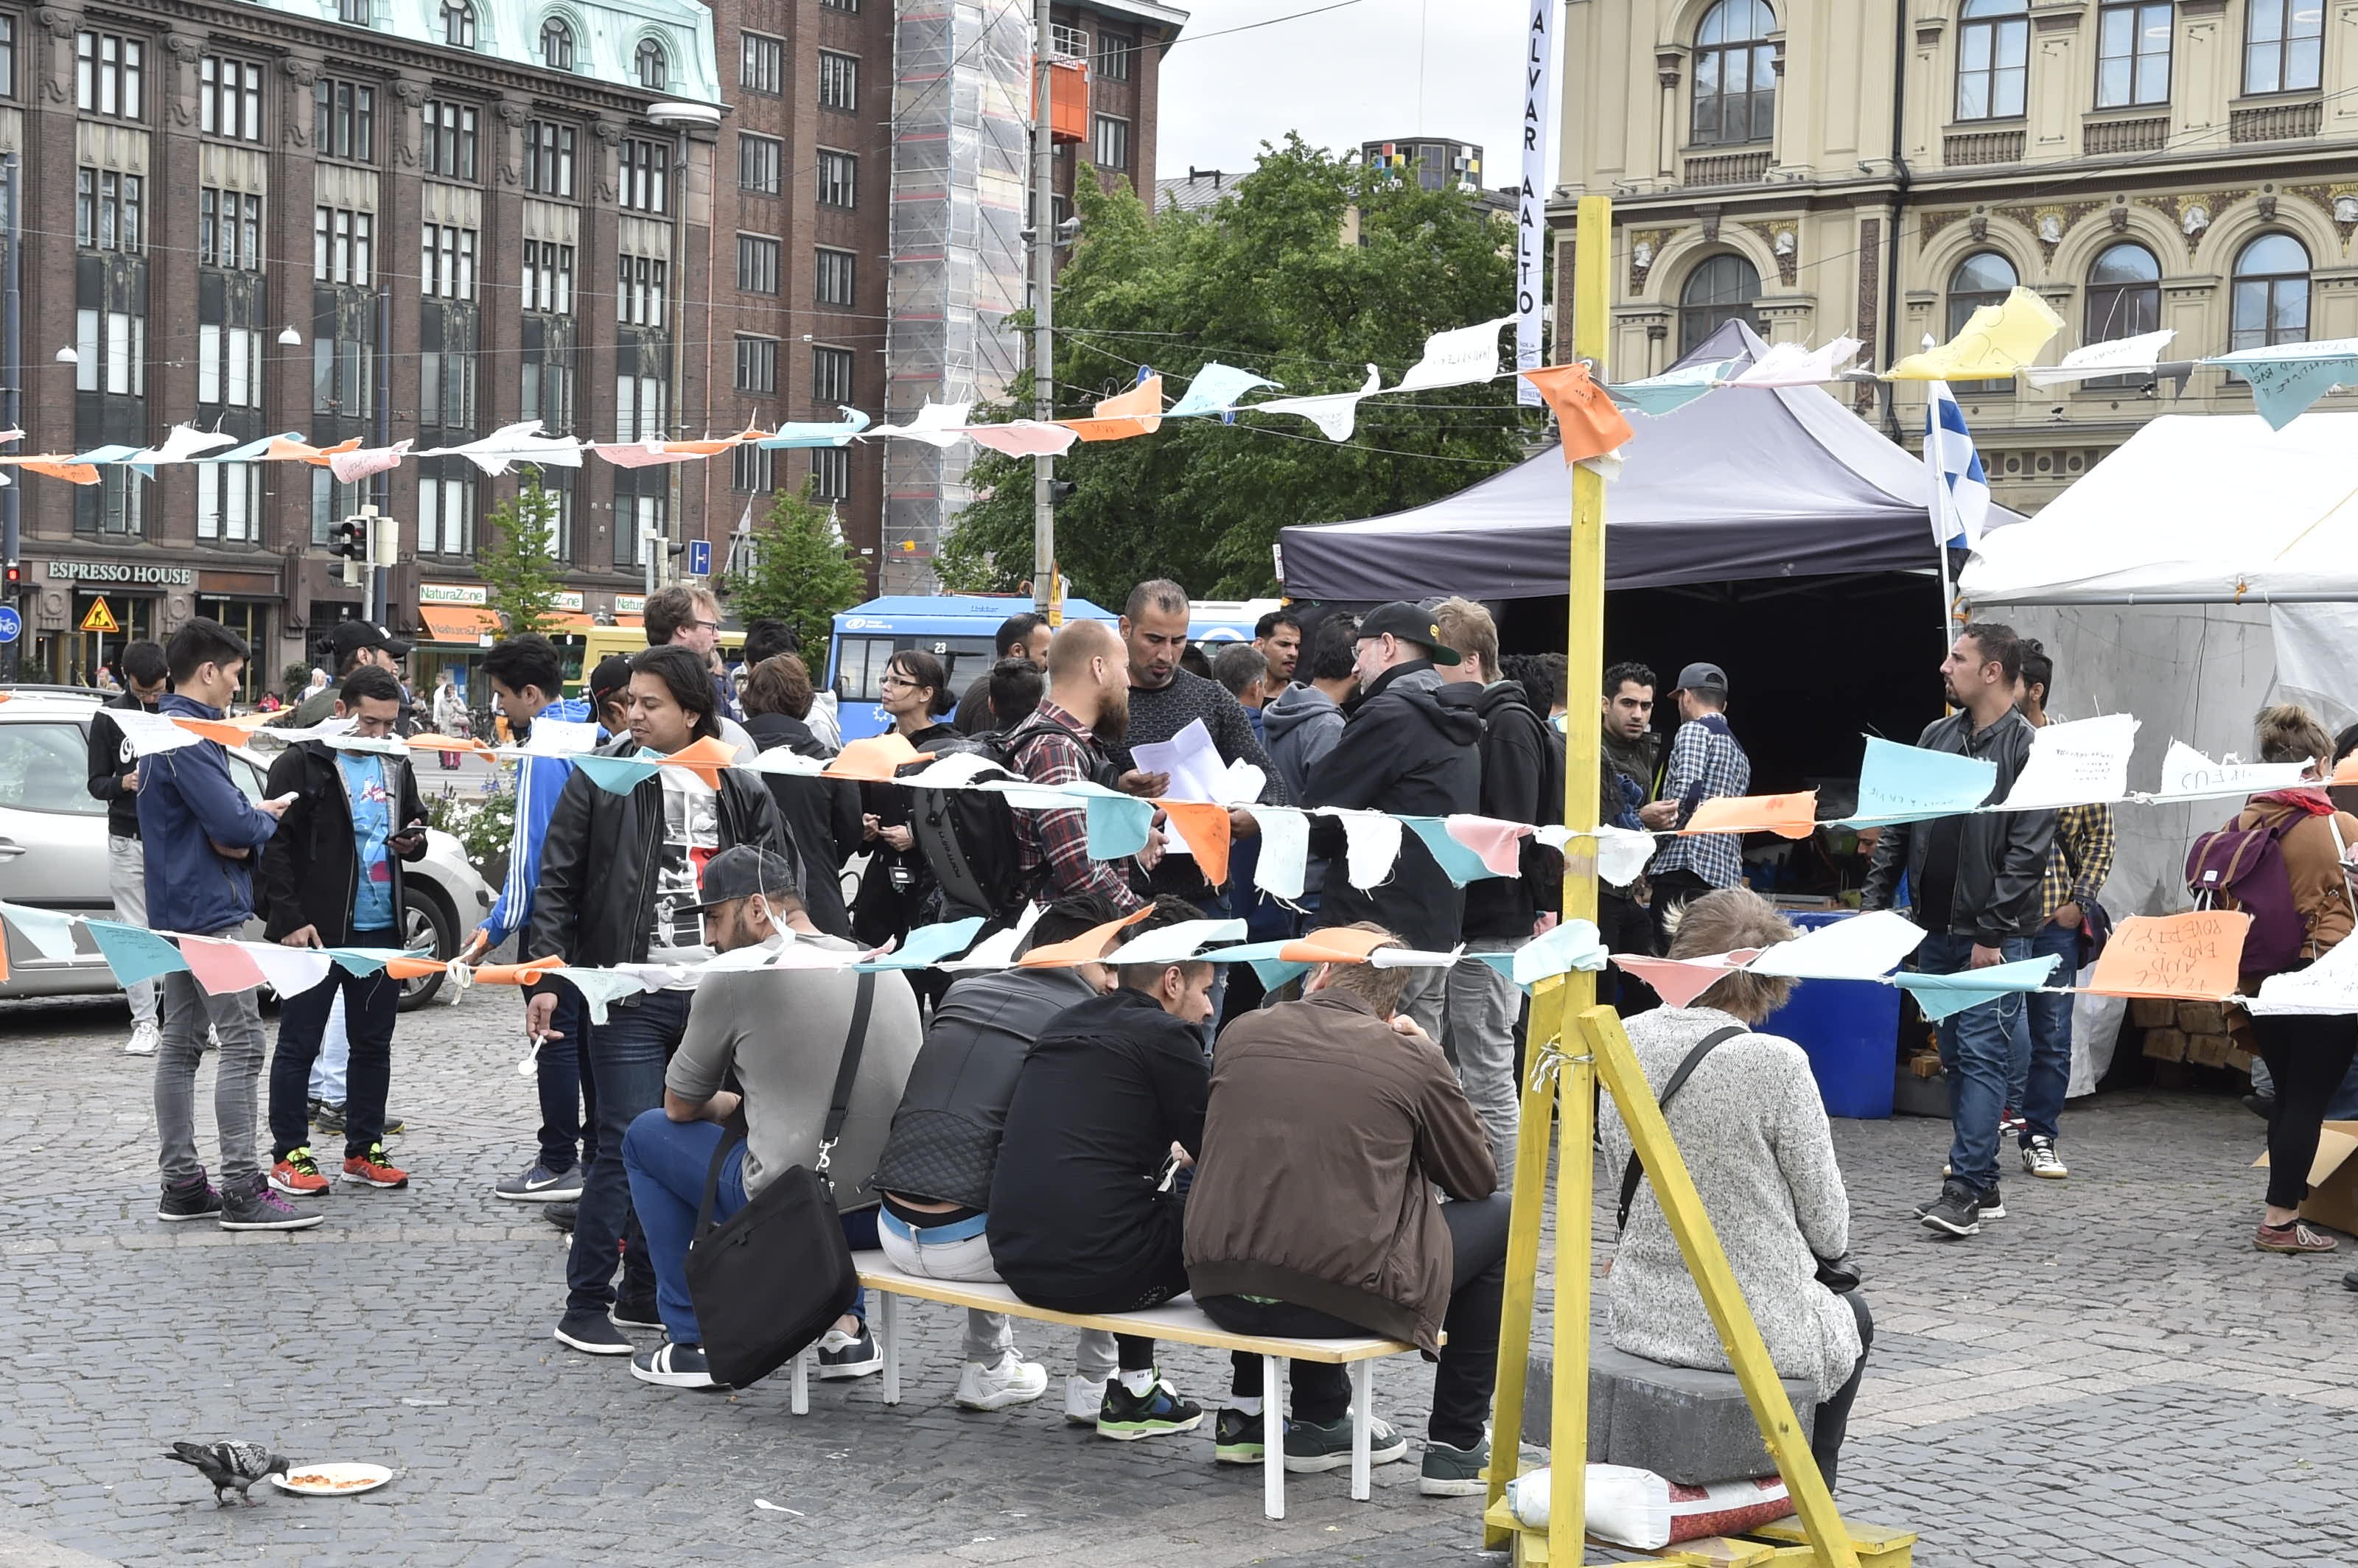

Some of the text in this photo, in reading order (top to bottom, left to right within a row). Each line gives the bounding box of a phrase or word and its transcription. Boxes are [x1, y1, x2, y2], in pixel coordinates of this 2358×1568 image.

[1519, 9, 1544, 314] ALVAR AALTO
[49, 561, 191, 584] ESPRESSO HOUSE
[421, 587, 483, 601] NaturaZone
[934, 642, 947, 654] 23
[2182, 941, 2218, 959] END
[2152, 957, 2197, 973] AND
